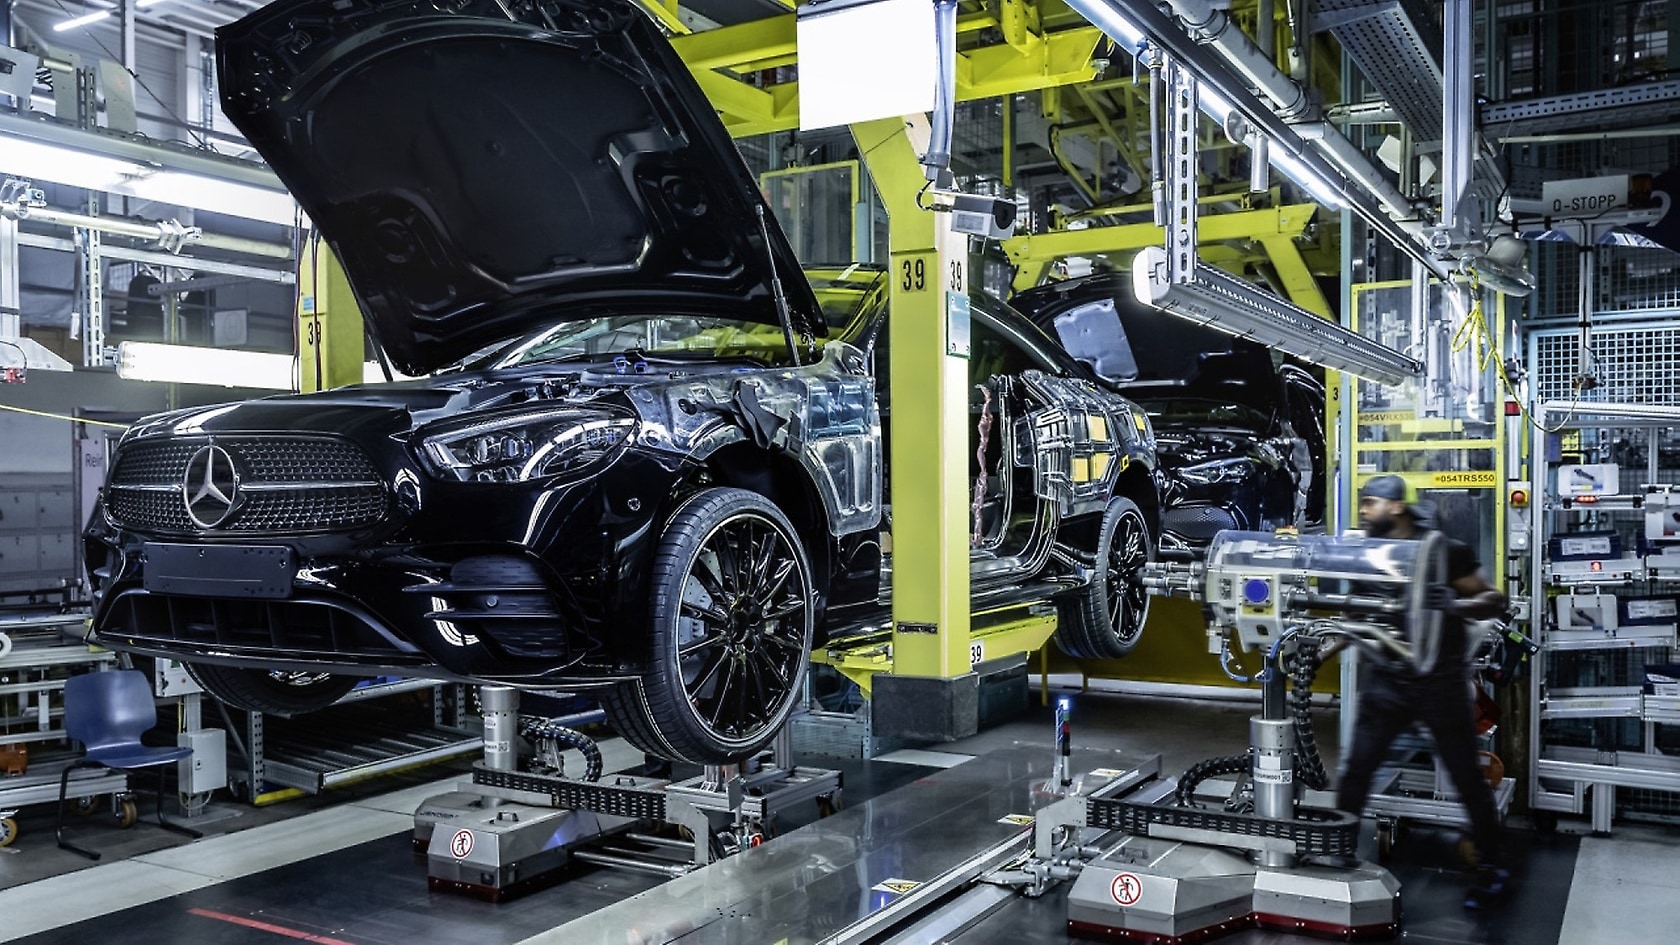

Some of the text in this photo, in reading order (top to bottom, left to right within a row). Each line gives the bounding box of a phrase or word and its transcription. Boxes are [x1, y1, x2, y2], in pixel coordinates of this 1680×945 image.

[903, 259, 924, 291] 39
[951, 260, 962, 291] 39
[971, 645, 982, 663] 39
